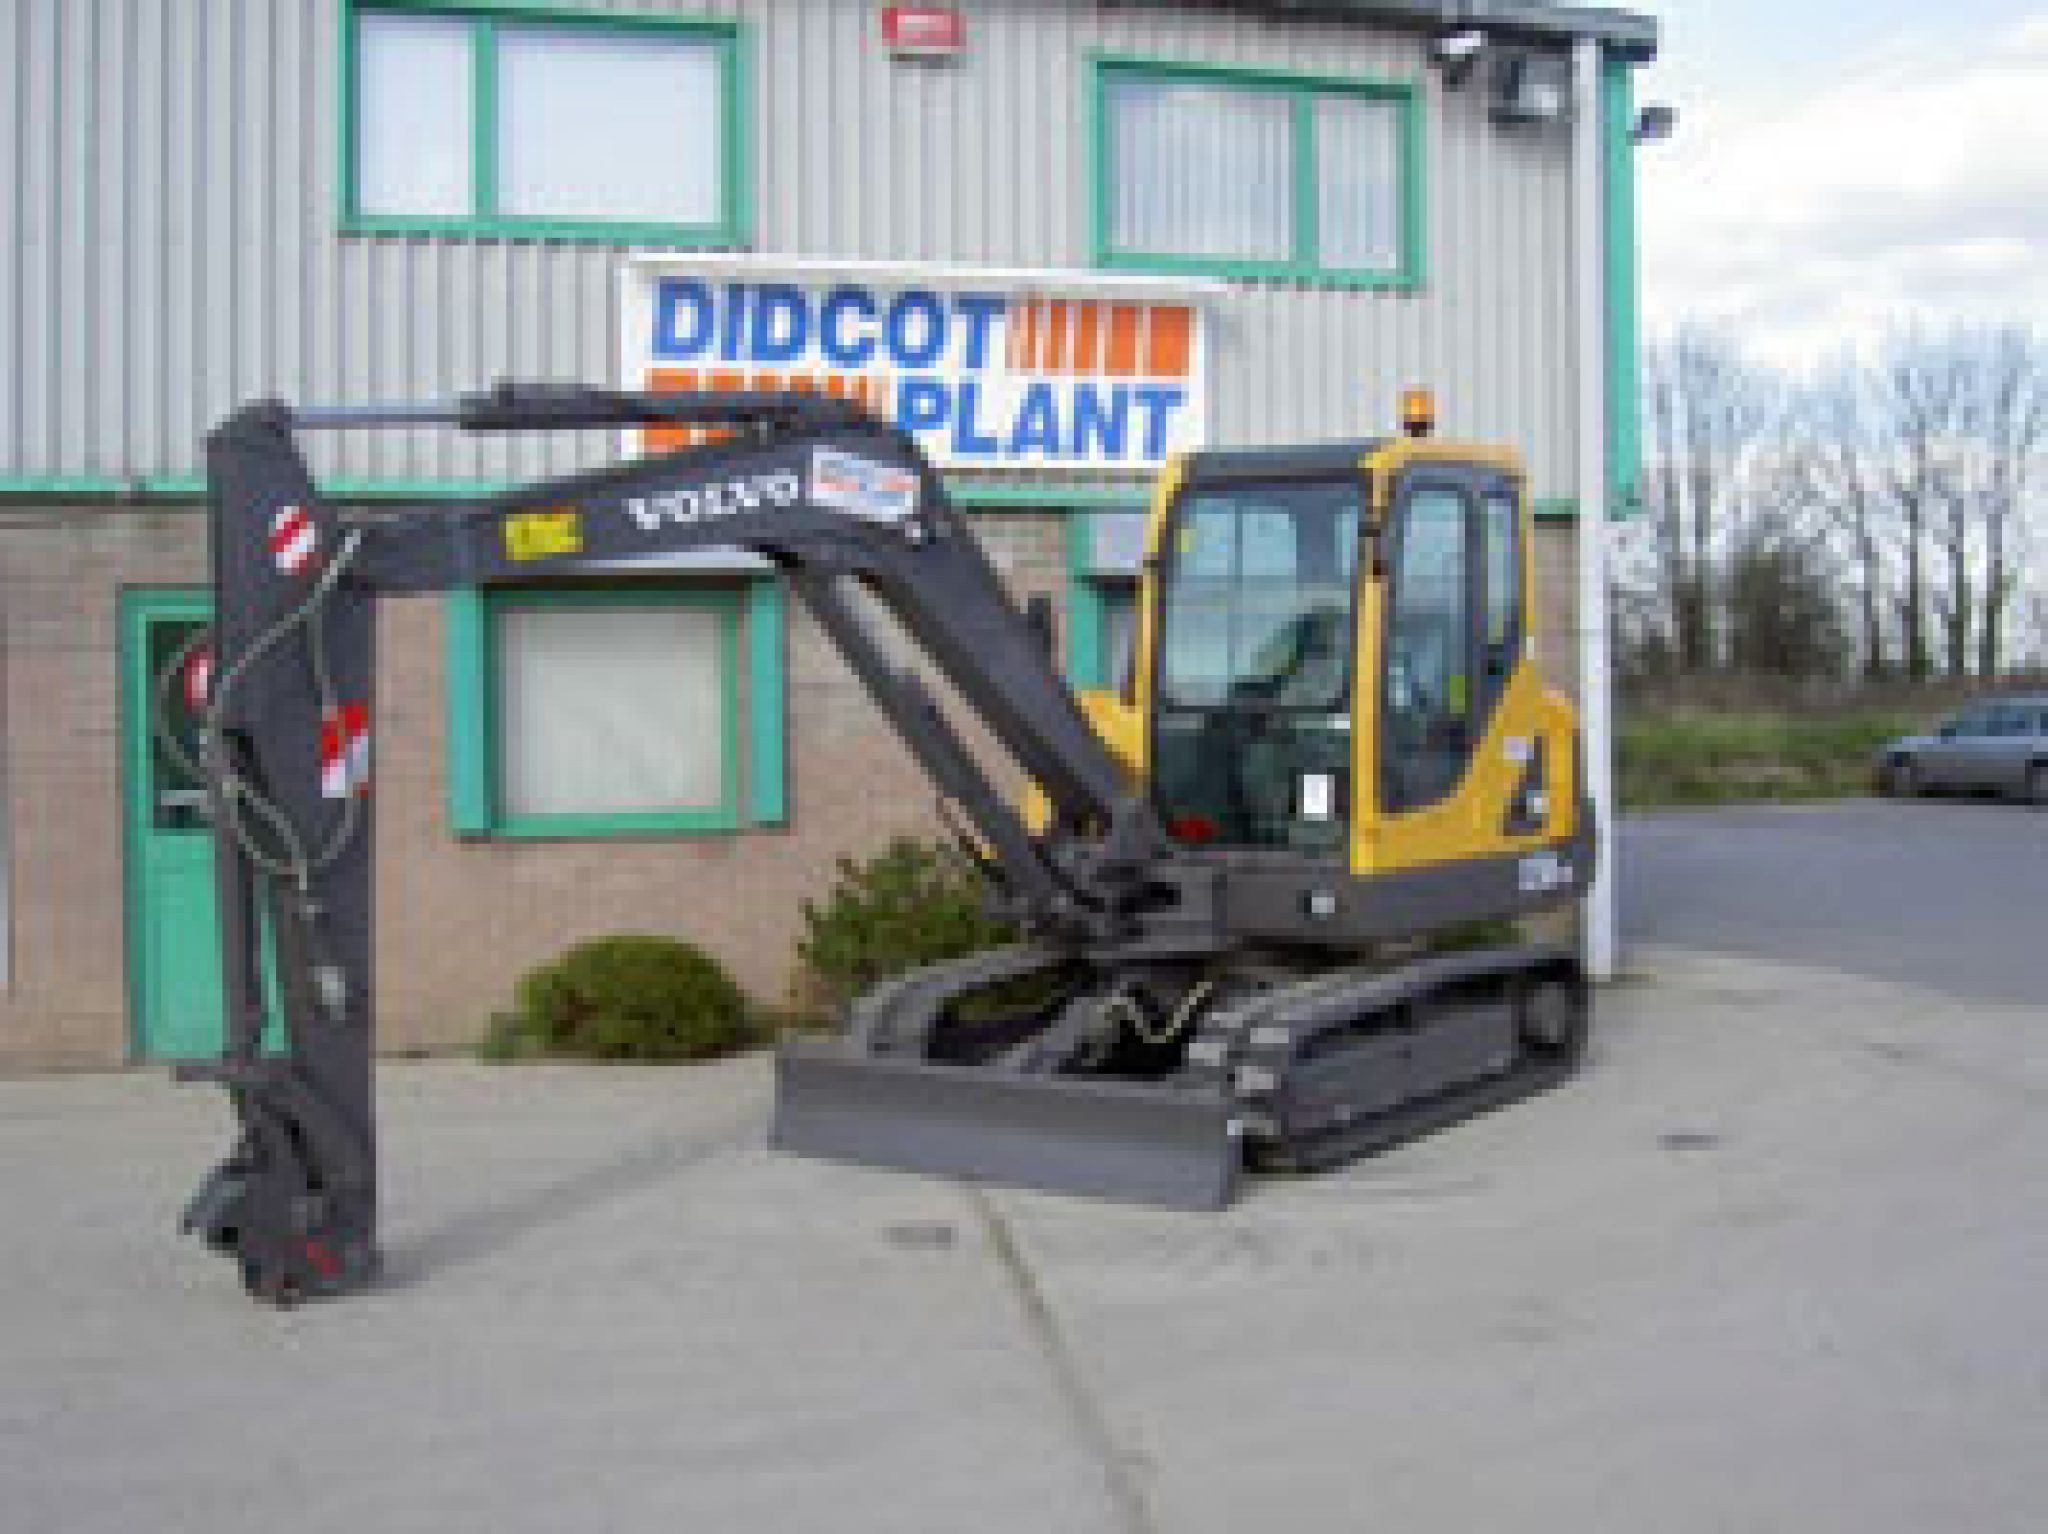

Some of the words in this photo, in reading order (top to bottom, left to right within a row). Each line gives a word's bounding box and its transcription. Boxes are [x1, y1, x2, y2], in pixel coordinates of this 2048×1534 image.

[652, 276, 1004, 367] DIDCOT
[898, 376, 1184, 458] PLANT
[626, 474, 799, 529] VOLVO
